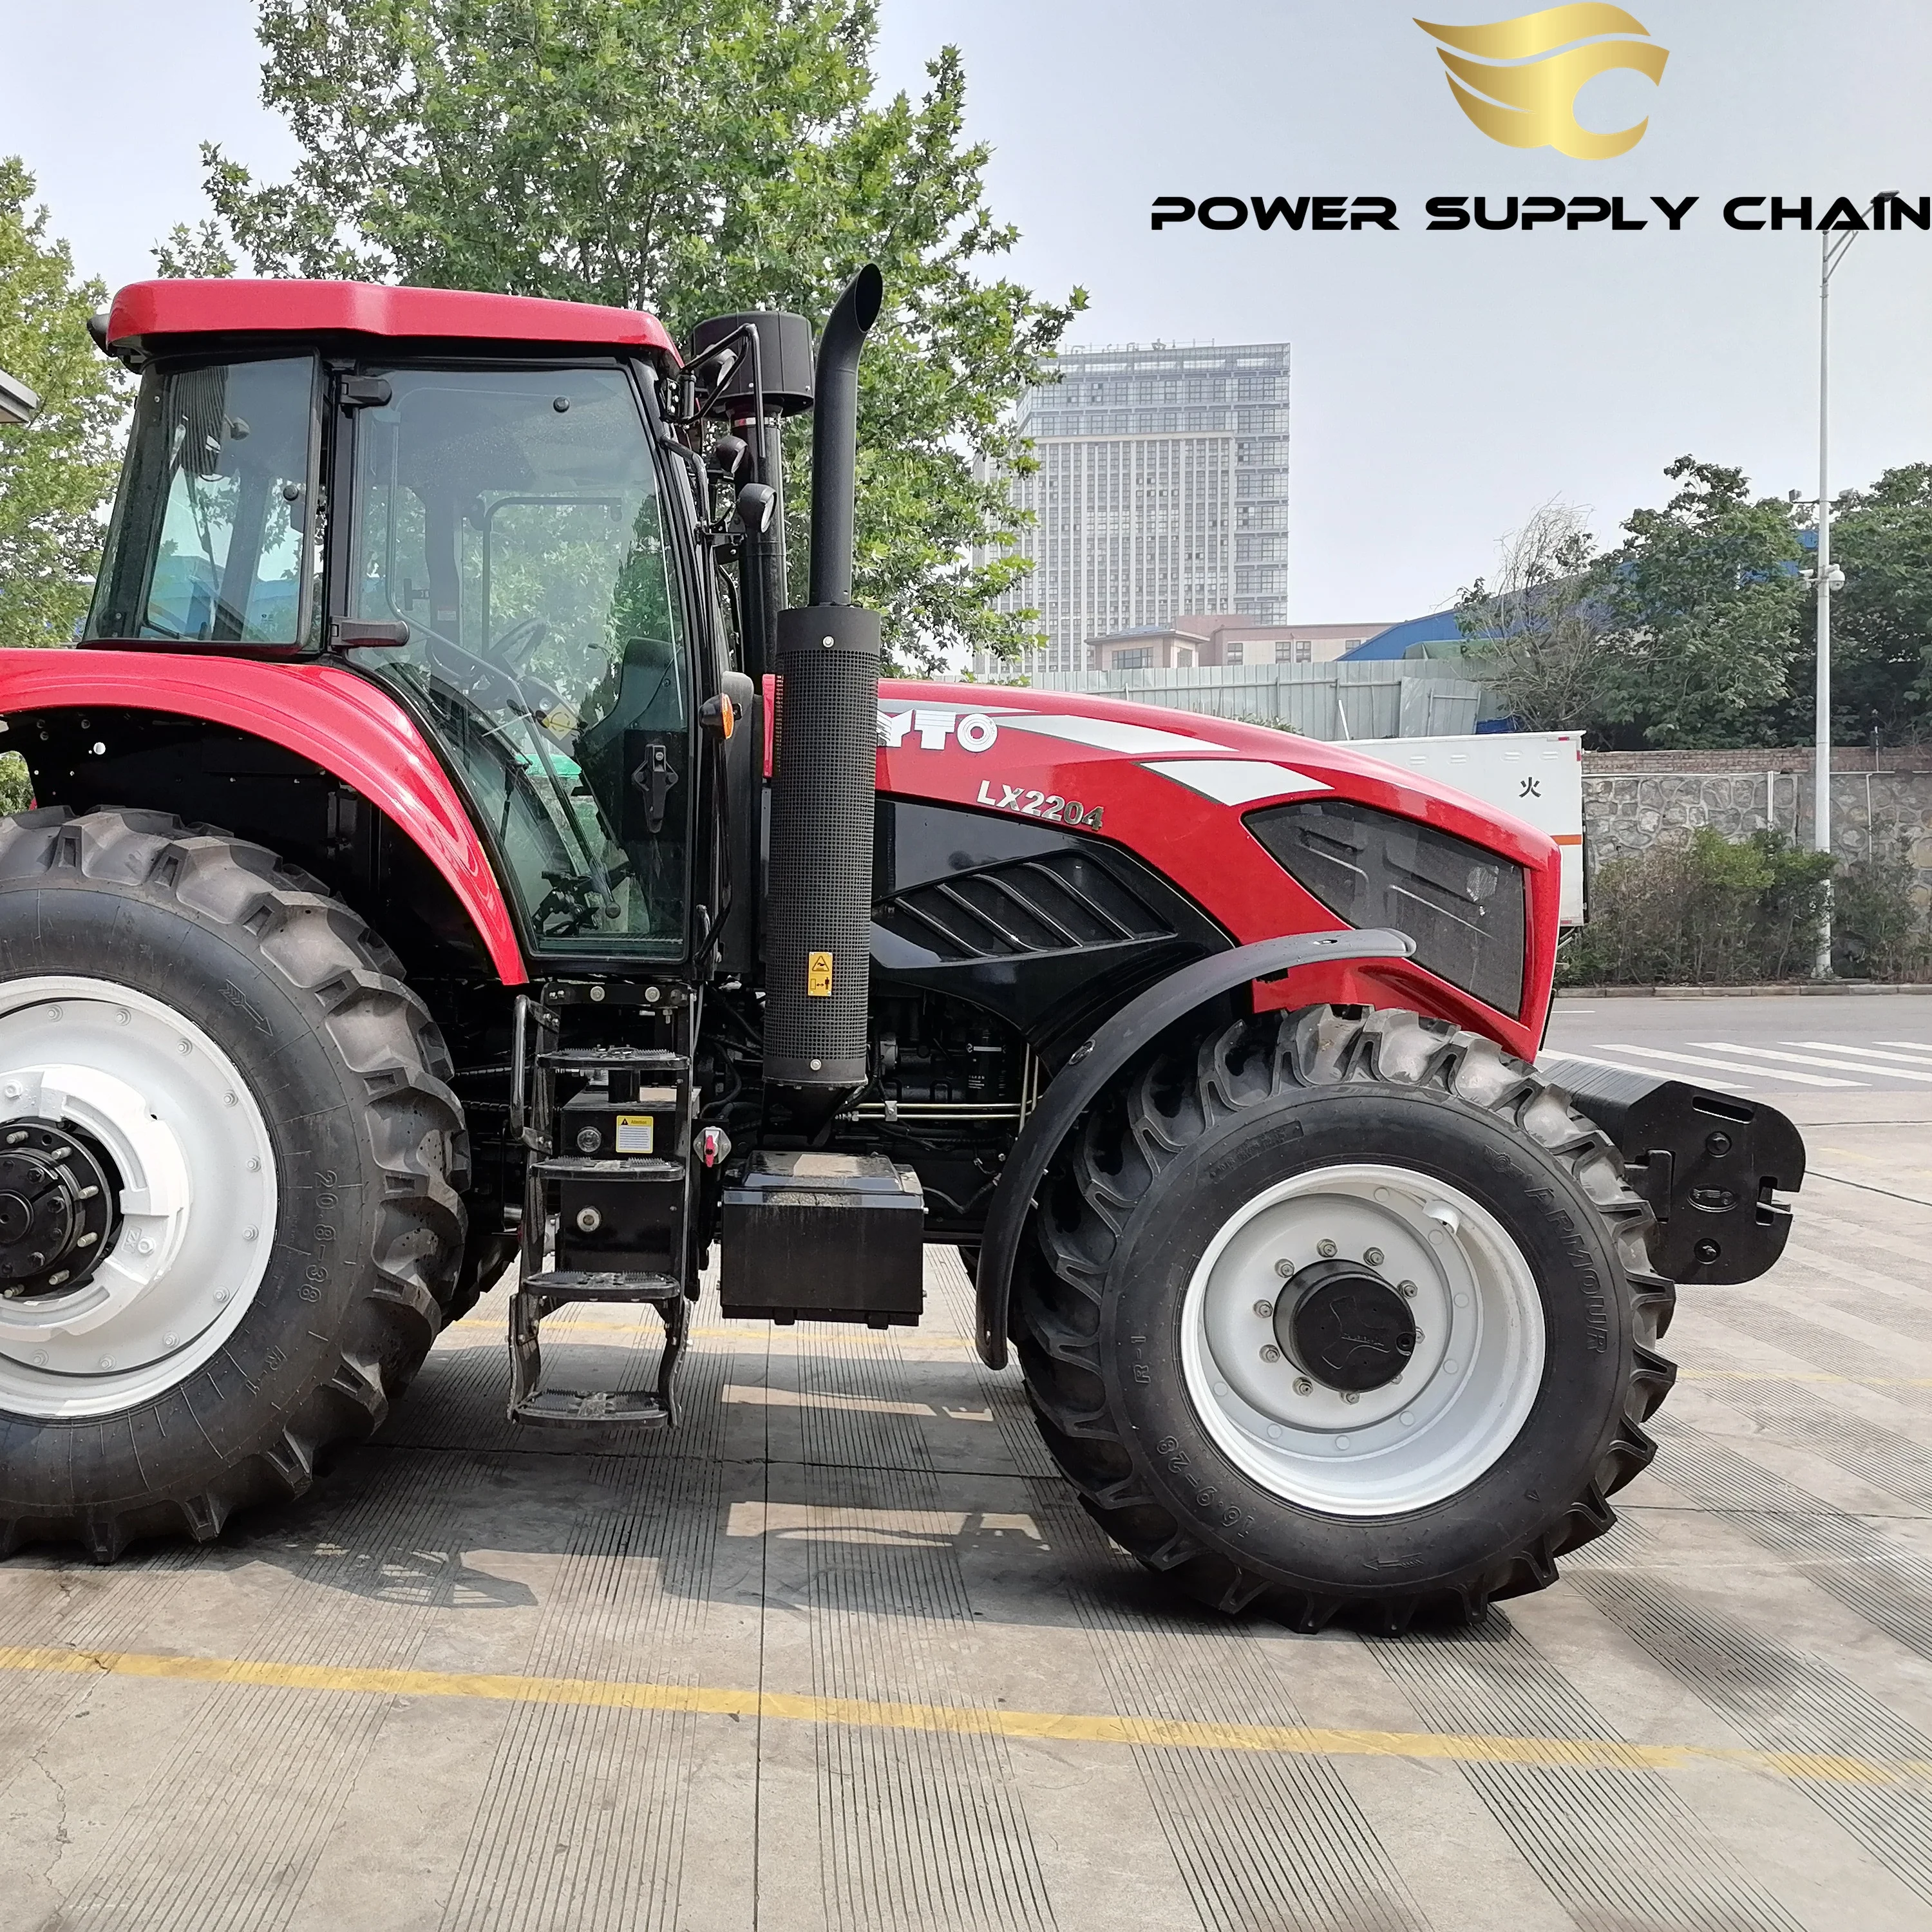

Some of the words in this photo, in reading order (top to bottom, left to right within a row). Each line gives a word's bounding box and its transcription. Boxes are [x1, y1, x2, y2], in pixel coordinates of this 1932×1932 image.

[876, 708, 998, 752] YTO
[976, 780, 1104, 830] LX2204
[1519, 777, 1542, 798] 火
[298, 1170, 338, 1302] 20.8-38
[1524, 1187, 1609, 1354] ARMOUR
